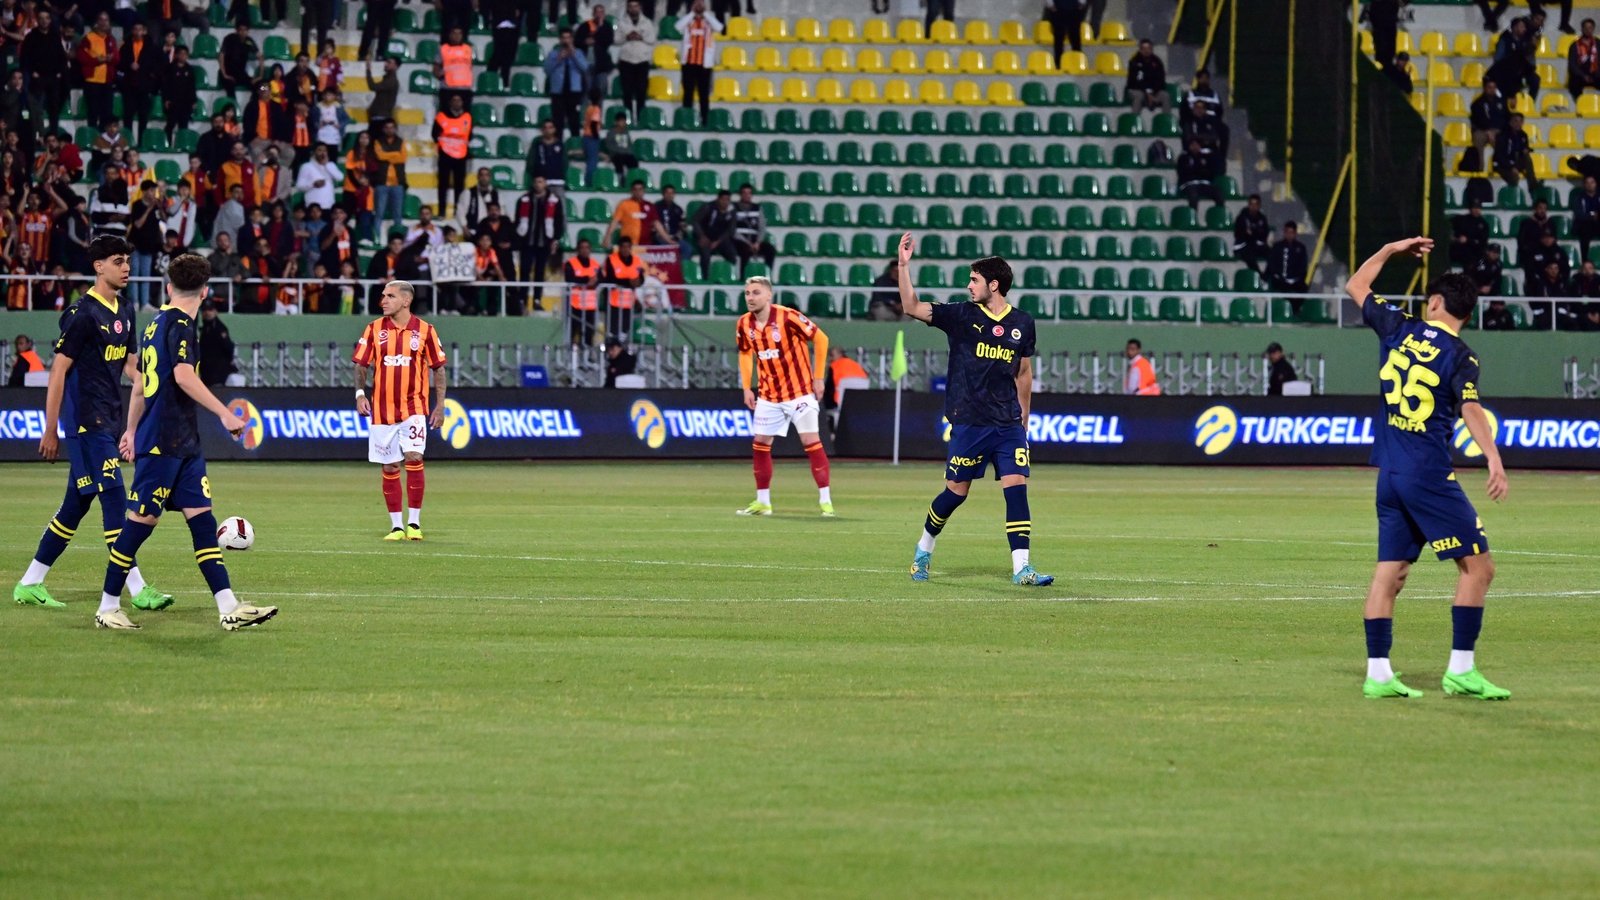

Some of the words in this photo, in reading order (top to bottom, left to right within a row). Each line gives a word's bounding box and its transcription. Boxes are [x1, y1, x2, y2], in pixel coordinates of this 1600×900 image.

[1380, 349, 1440, 422] 55
[408, 425, 425, 442] 34
[469, 409, 582, 438] TURKCELL
[663, 409, 755, 438] TURKCEL
[1240, 416, 1375, 444] TURKCELL
[1503, 419, 1600, 448] TURKC
[950, 455, 983, 467] AYGAZ
[1014, 447, 1031, 468] 5
[1432, 536, 1462, 553] SHA
